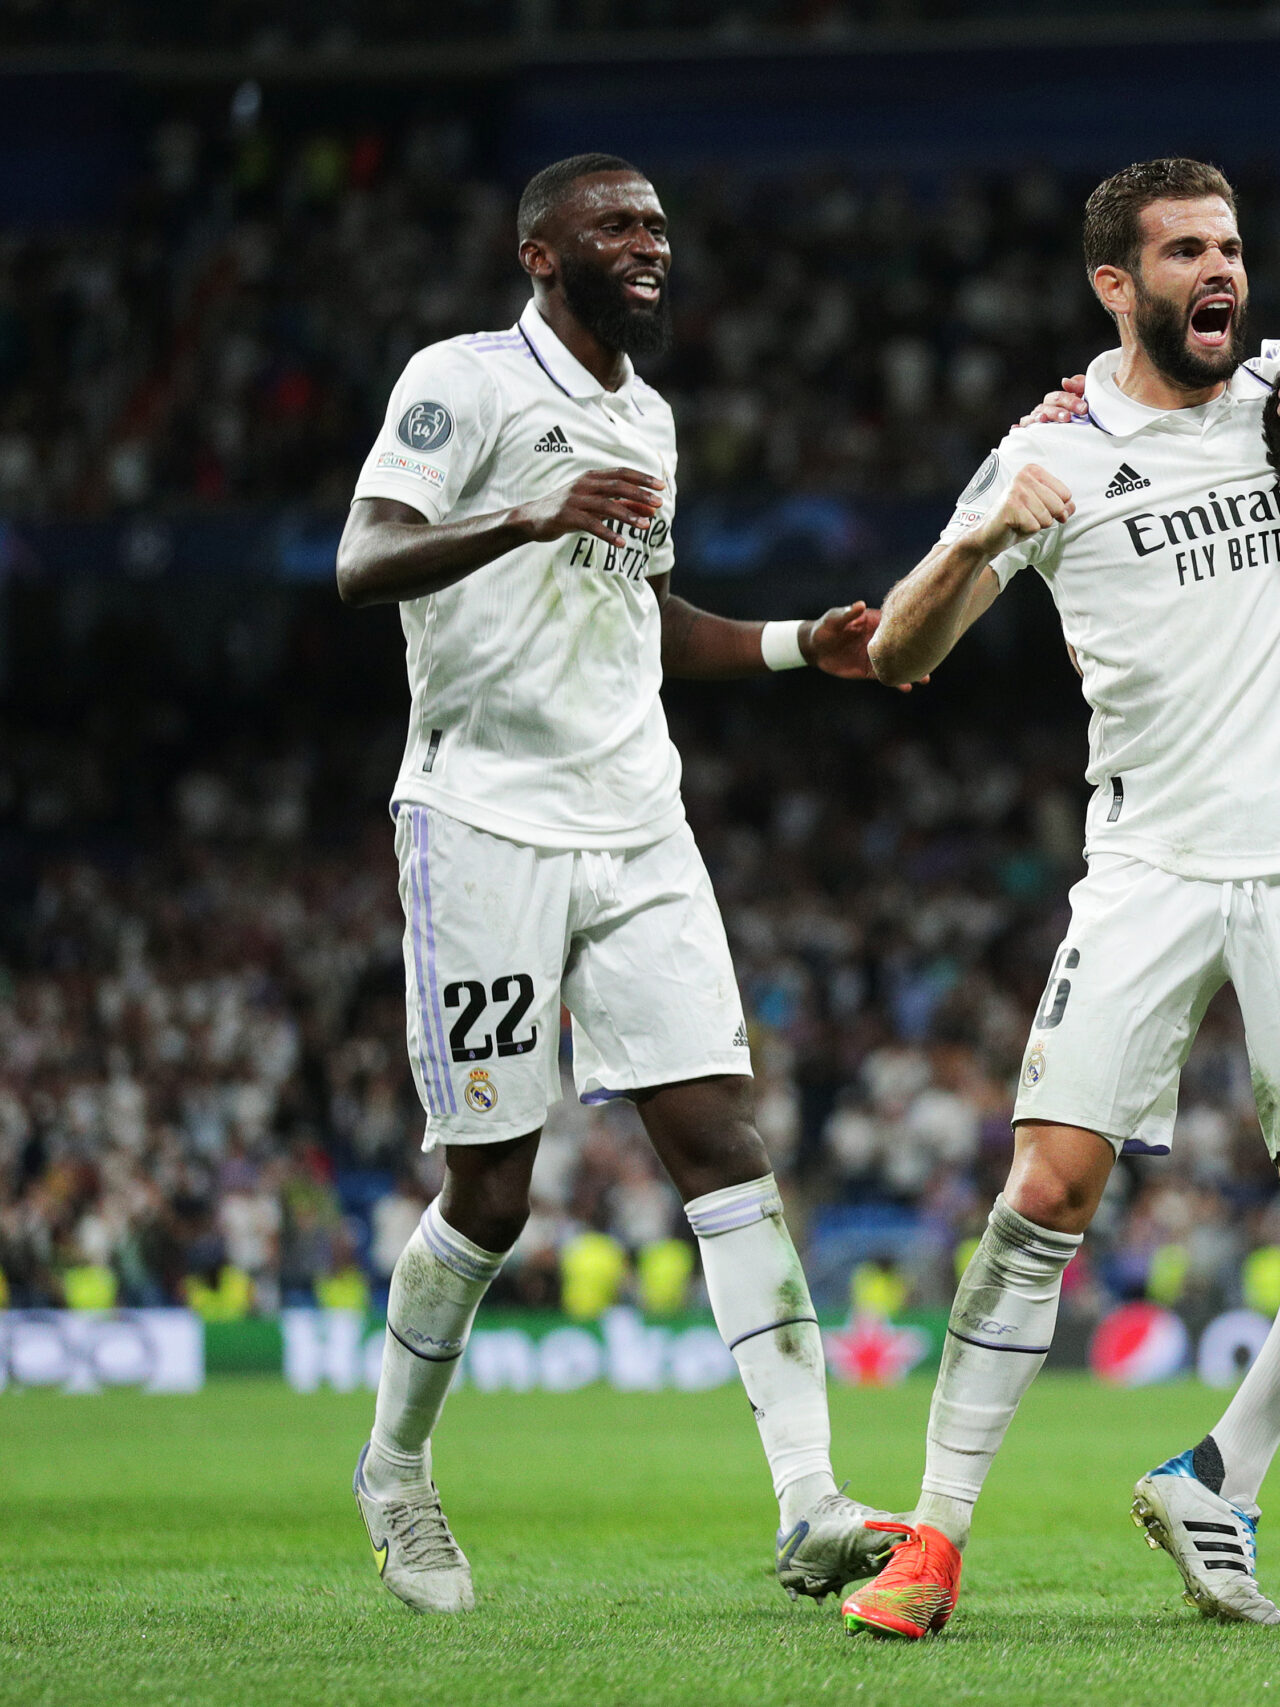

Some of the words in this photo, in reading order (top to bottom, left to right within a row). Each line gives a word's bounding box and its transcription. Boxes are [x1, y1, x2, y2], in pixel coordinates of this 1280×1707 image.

[413, 423, 431, 438] 14
[534, 442, 574, 454] adidas
[377, 457, 445, 484] FOUNDATION
[1105, 476, 1151, 498] adidas
[1175, 544, 1215, 586] FLY
[1035, 947, 1081, 1029] 6
[443, 973, 537, 1062] 22
